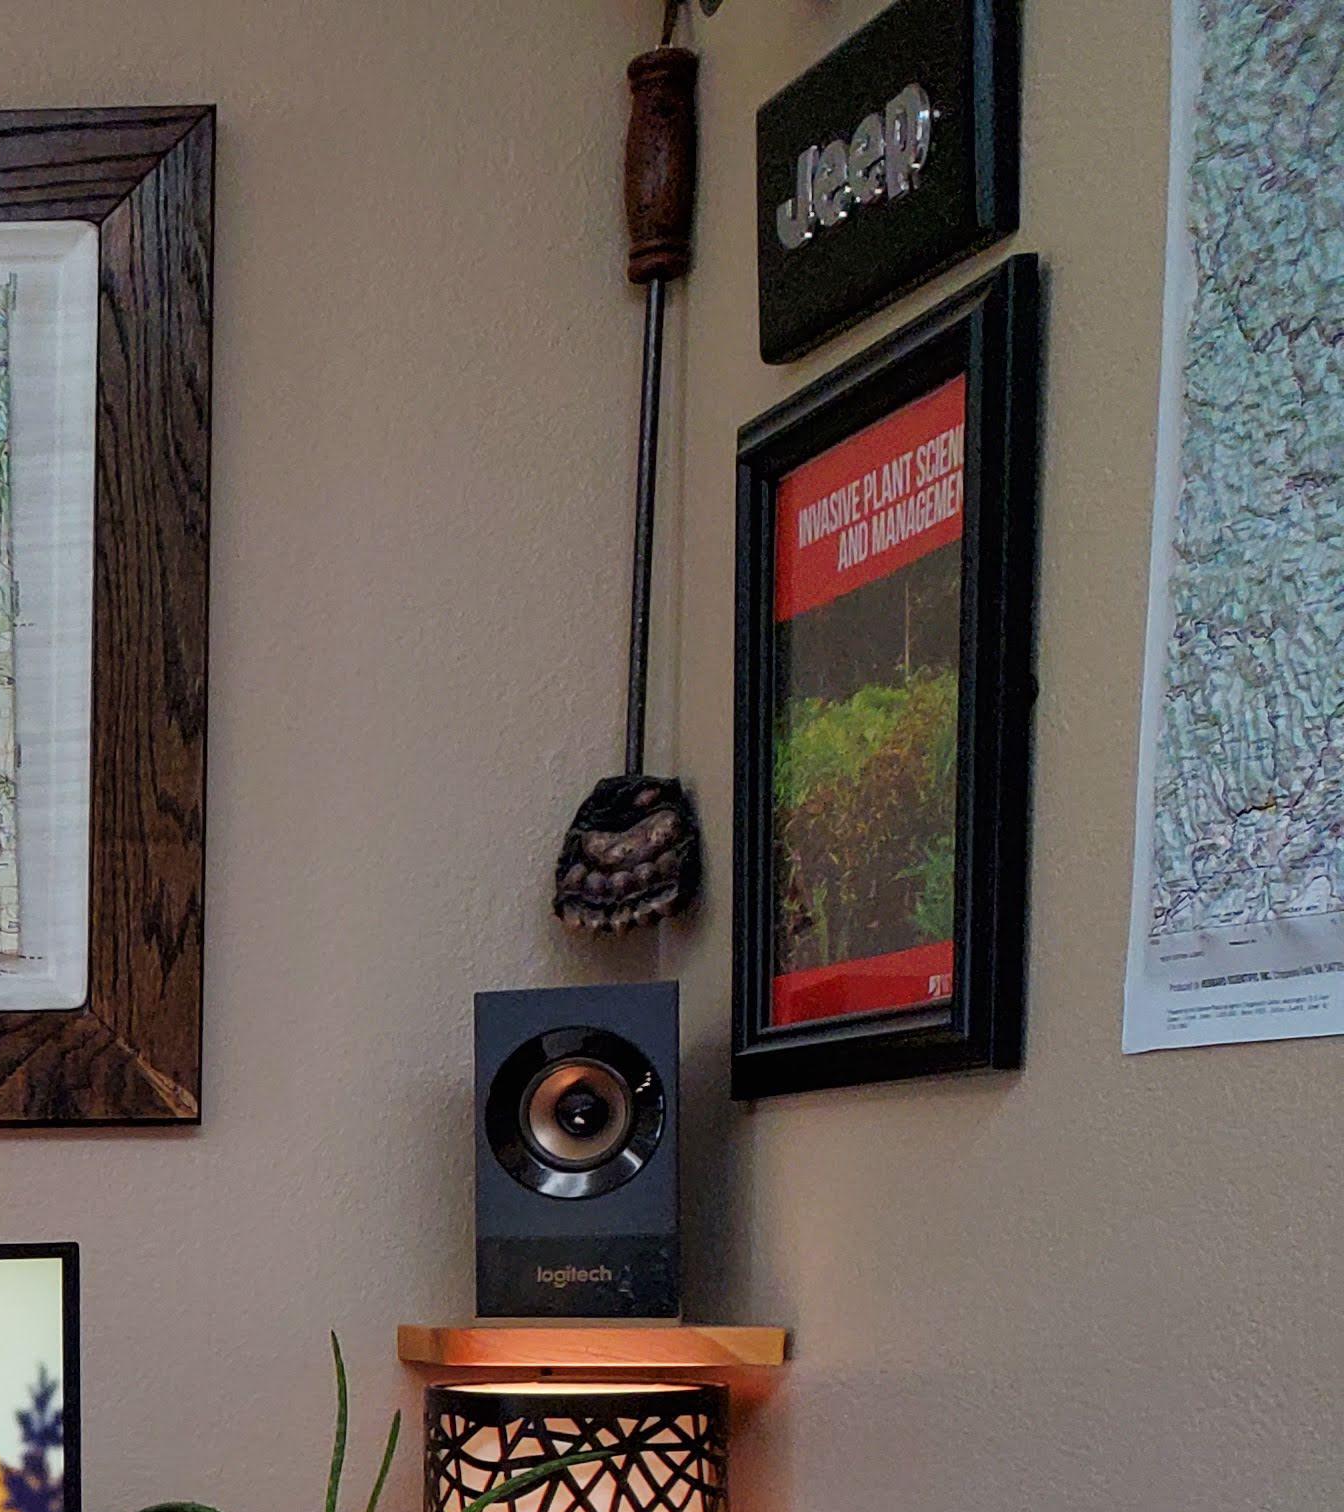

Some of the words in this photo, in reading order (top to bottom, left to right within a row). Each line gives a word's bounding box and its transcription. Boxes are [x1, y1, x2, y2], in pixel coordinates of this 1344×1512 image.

[776, 83, 930, 249] Jeep
[798, 480, 862, 549] INVASIVE
[863, 452, 913, 514] PLANT
[837, 520, 868, 572] AND
[537, 1264, 612, 1288] logitech
